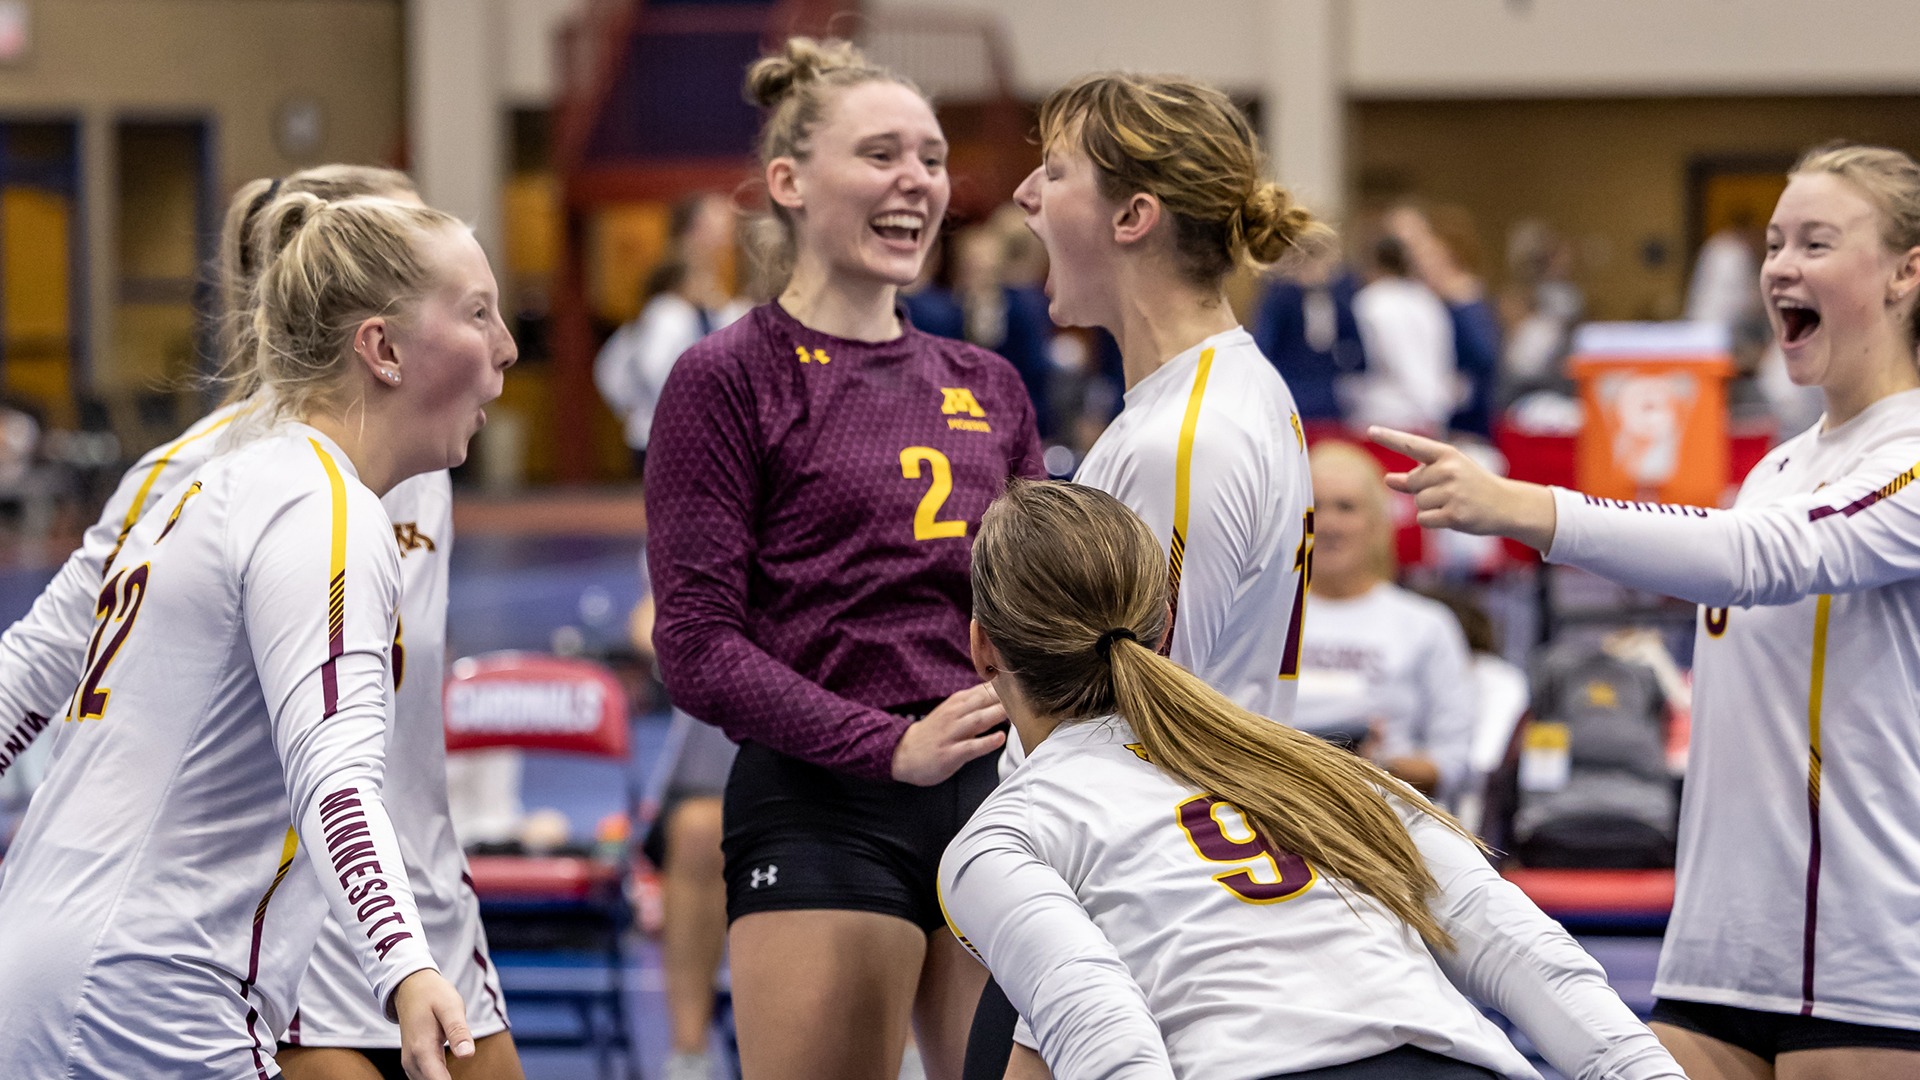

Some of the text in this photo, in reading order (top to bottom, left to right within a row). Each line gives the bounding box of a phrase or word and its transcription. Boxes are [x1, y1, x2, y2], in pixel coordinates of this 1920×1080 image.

[941, 387, 986, 418] M
[899, 446, 967, 541] 2
[65, 561, 151, 722] 12
[319, 787, 413, 962] MINNESOTA
[1174, 790, 1318, 906] 9
